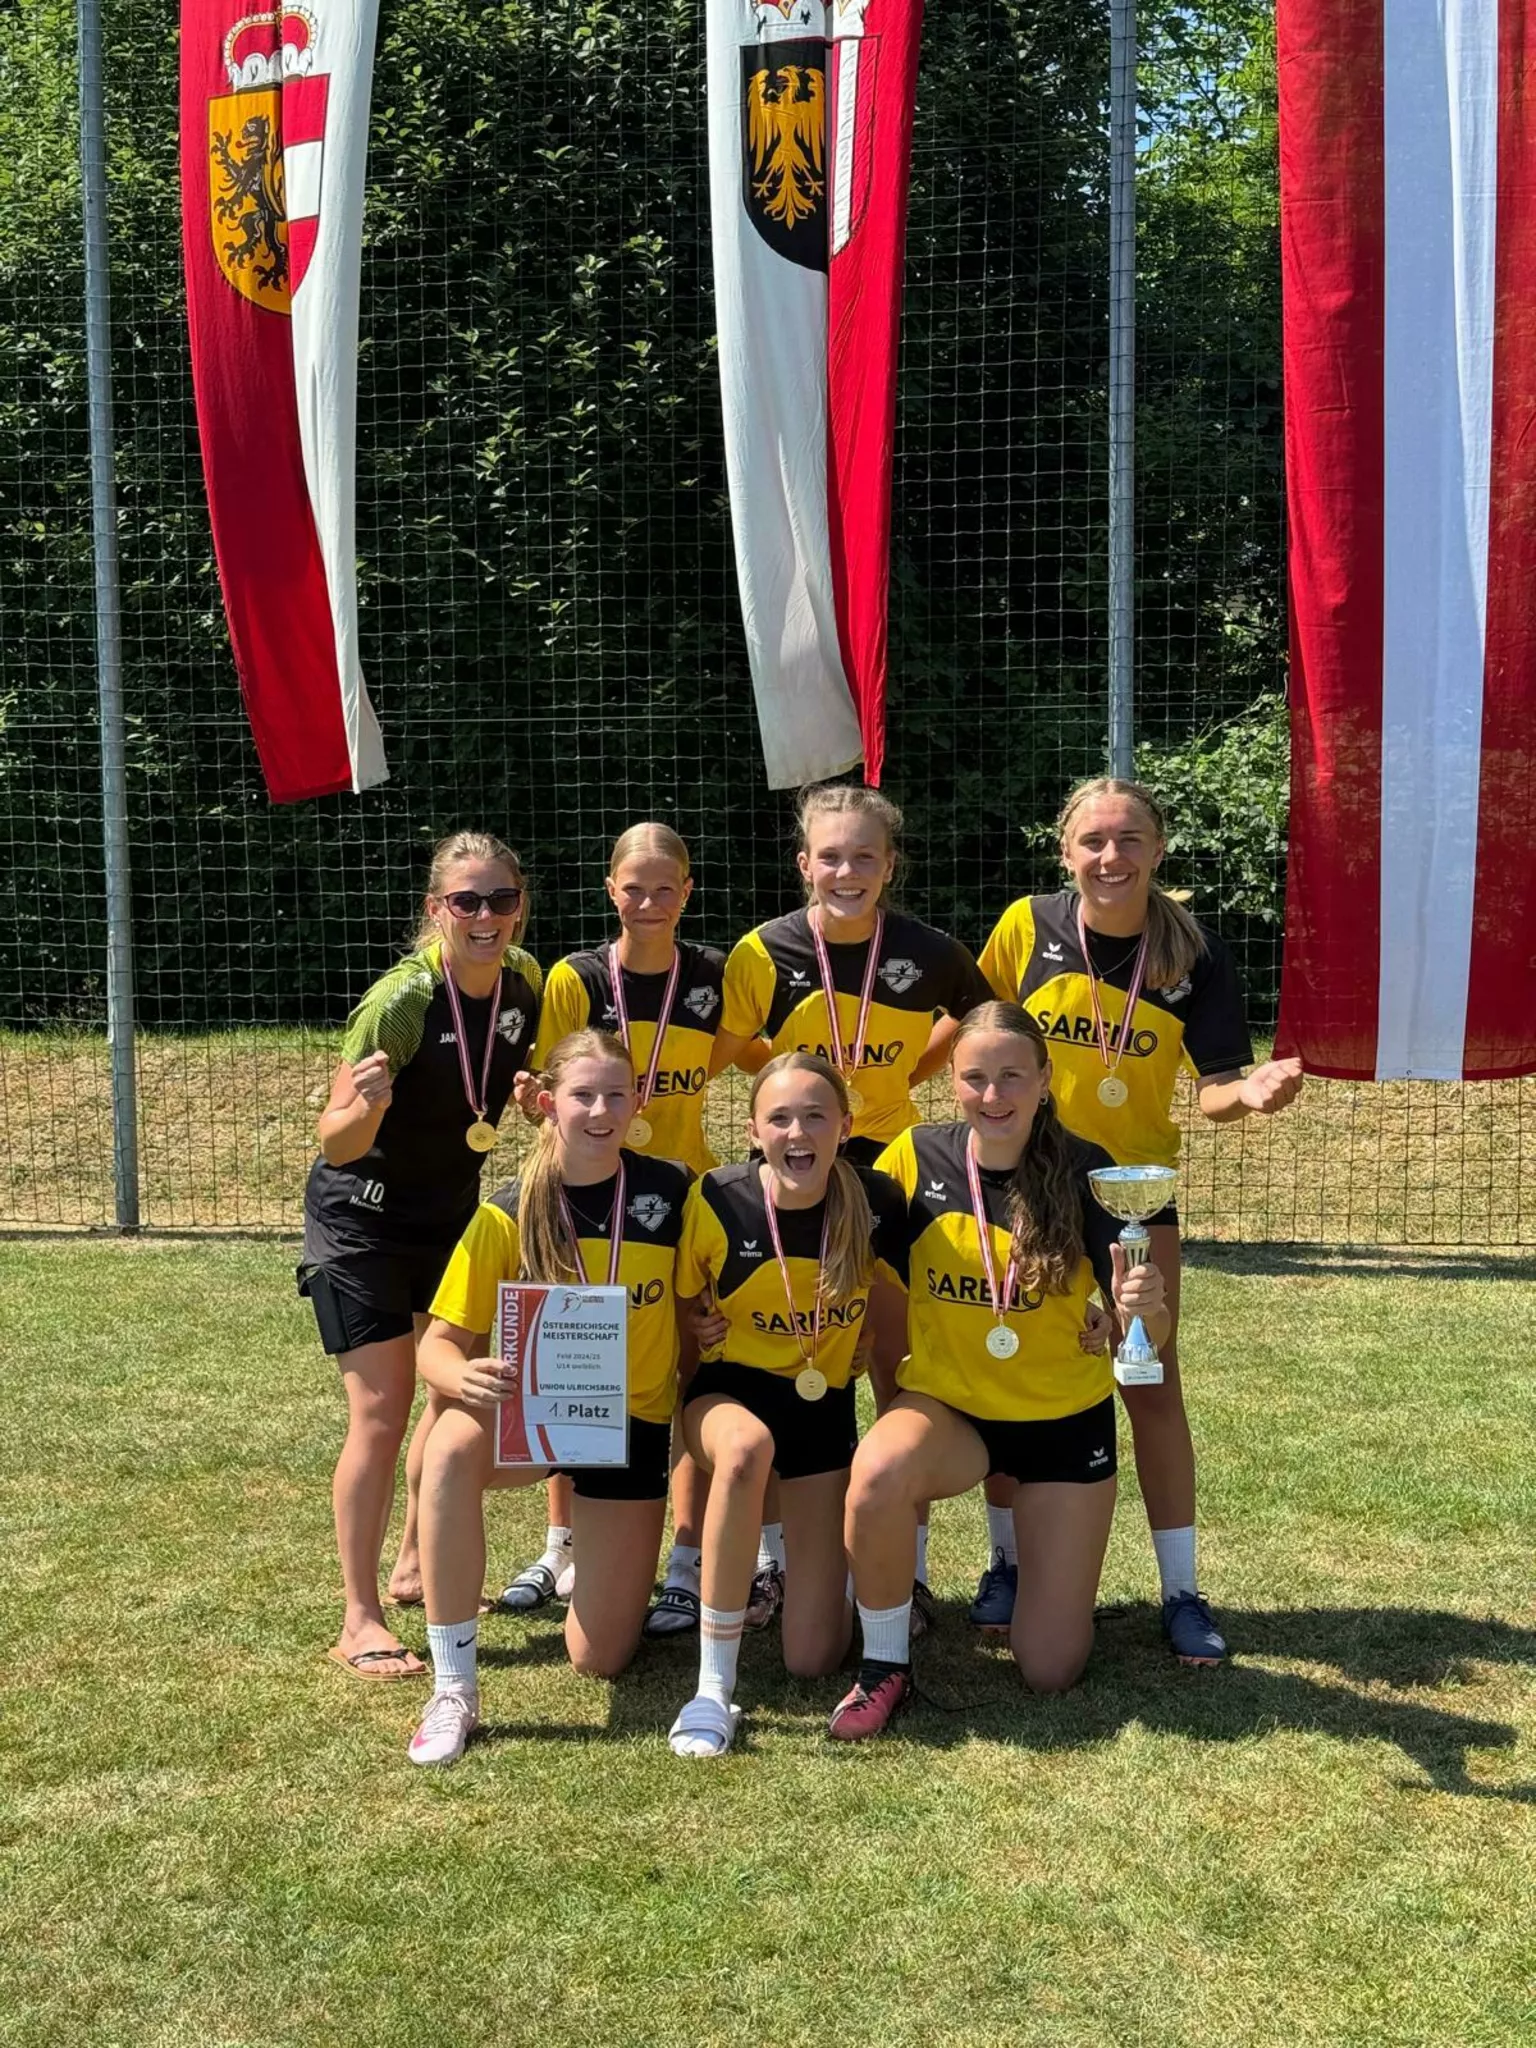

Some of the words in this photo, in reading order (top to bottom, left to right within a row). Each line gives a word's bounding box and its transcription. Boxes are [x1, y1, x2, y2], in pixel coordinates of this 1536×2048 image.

[440, 1032, 457, 1044] JAK
[362, 1179, 385, 1204] 10
[542, 1321, 620, 1331] ÖSTERREICHISCHE
[543, 1331, 619, 1341] MEISTERSCHAFT
[539, 1383, 565, 1391] UNION
[566, 1384, 622, 1392] ULRICHSBERG
[567, 1403, 611, 1418] Platz
